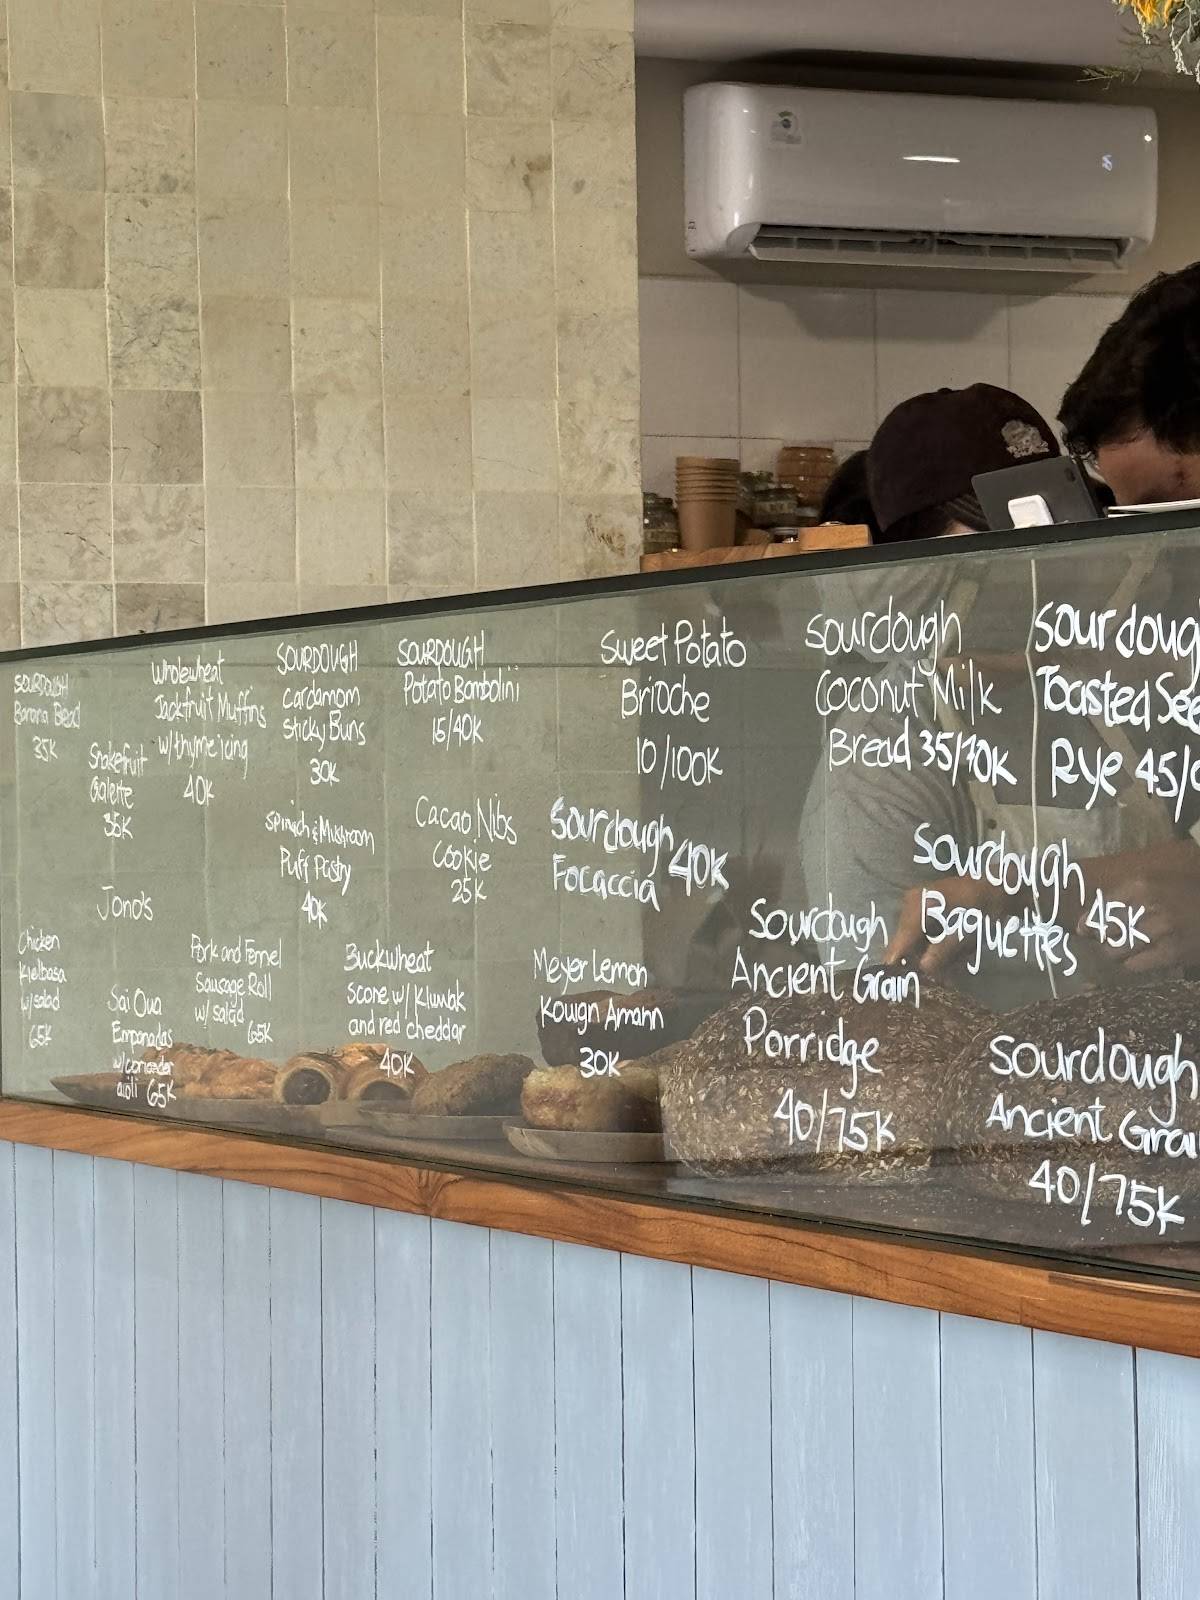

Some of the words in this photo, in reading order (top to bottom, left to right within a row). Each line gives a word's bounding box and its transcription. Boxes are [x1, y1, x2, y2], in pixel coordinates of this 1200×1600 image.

[276, 639, 359, 676] SOURDOUGH
[396, 629, 485, 671] SOURDOUGH
[600, 622, 669, 666] Sweet
[673, 616, 747, 669] Potato
[403, 665, 451, 707] Potato
[620, 673, 710, 723] Brioche
[815, 666, 925, 716] Coconut
[932, 658, 1003, 726] Milk
[1036, 664, 1151, 733] Toasted
[329, 709, 367, 746] Buns
[431, 708, 484, 752] 15/40K
[828, 716, 912, 772] Bread
[183, 773, 215, 807] 40K
[309, 757, 341, 787] 30K
[1051, 737, 1124, 811] Rye
[415, 795, 472, 835] Cacao
[476, 792, 518, 845] Nibs
[550, 795, 674, 877] Sourdough
[279, 845, 310, 884] Puff
[432, 839, 492, 878] Cookie
[913, 822, 1086, 927] Sourdough
[96, 884, 154, 921] Jono's
[450, 877, 488, 905] 25K
[551, 853, 661, 913] Focaccia
[749, 892, 889, 953] Sourdough
[921, 887, 1078, 977] Baguettes
[1084, 888, 1151, 950] 45K
[190, 932, 219, 963] Pork
[220, 935, 242, 964] and
[343, 938, 435, 974] Buckwheat
[247, 971, 273, 1002] Roll
[533, 946, 588, 996] Meyer
[592, 948, 648, 988] Lemon
[731, 946, 847, 1001] Ancient
[852, 953, 920, 1009] Grain
[107, 984, 131, 1013] Sai
[212, 997, 245, 1027] salad
[348, 1008, 376, 1036] and
[378, 1010, 401, 1036] red
[379, 1047, 416, 1079] 40K
[579, 1046, 621, 1079] 30K
[743, 1006, 883, 1100] Porridge
[146, 1078, 177, 1108] 65K
[988, 1026, 1199, 1127] Sourdough
[773, 1088, 897, 1154] 40/75K
[985, 1092, 1113, 1144] Ancient
[1118, 1109, 1200, 1160] Grai
[1028, 1159, 1185, 1236] 40/75K
